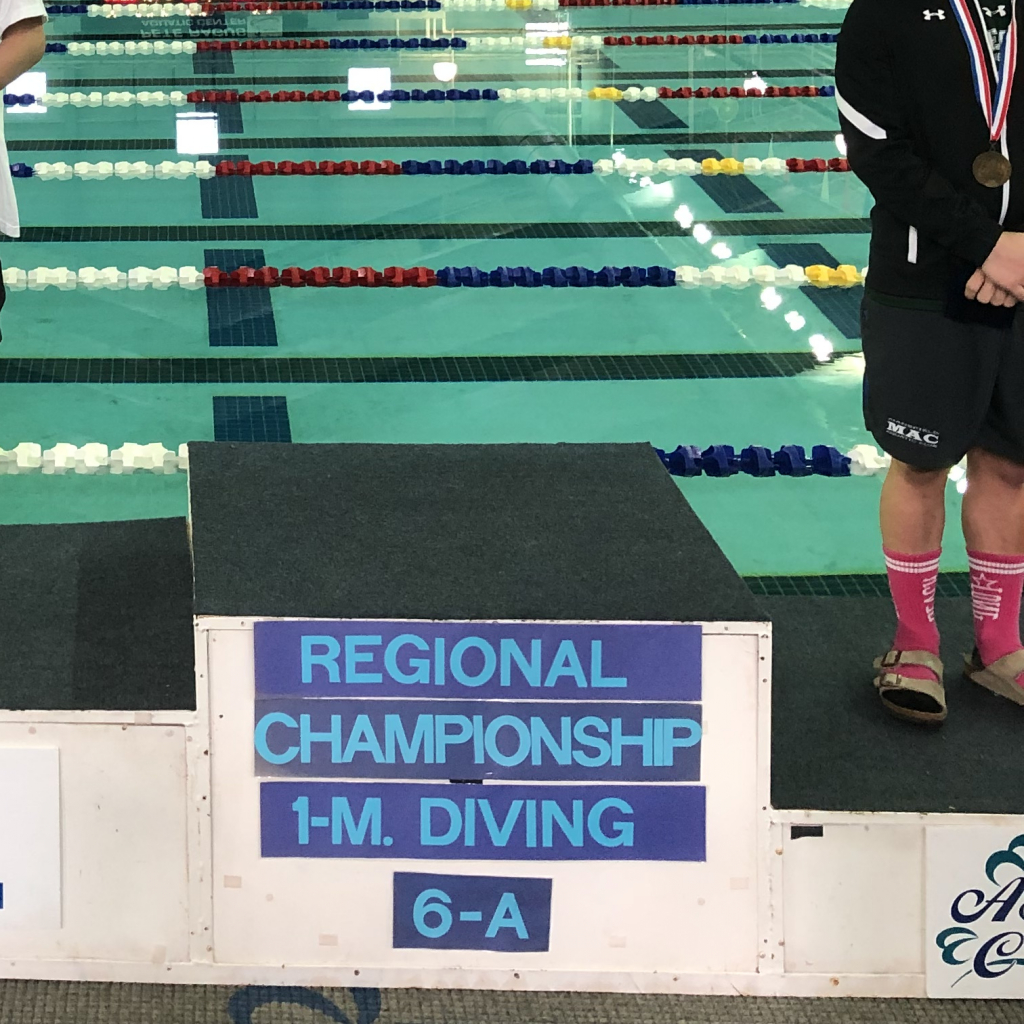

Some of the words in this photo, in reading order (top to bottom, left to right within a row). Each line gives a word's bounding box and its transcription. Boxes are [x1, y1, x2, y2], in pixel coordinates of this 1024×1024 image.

[886, 420, 939, 445] MAC
[300, 633, 628, 688] REGIONAL
[254, 712, 703, 767] CHAMPIONSHIP
[291, 795, 394, 847] 1-M.
[420, 796, 635, 848] DIVING
[412, 888, 530, 940] 6-A
